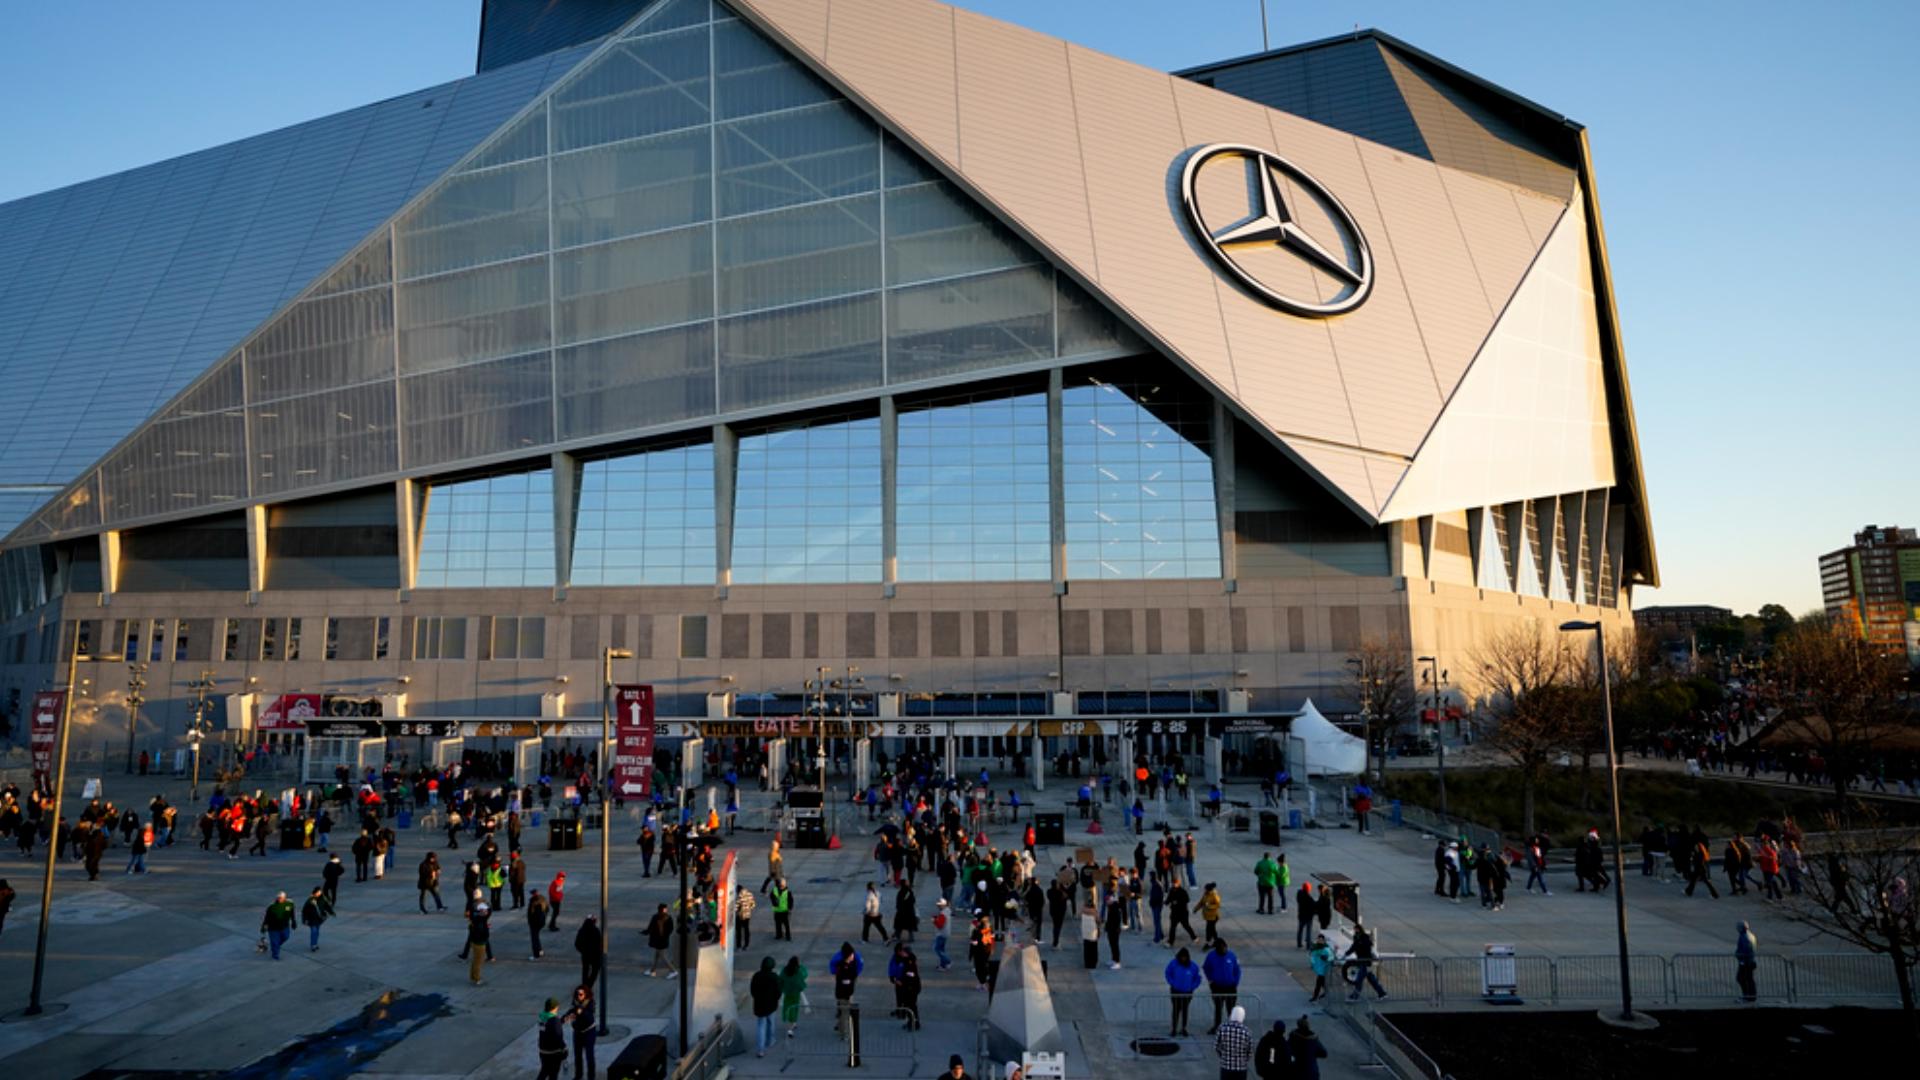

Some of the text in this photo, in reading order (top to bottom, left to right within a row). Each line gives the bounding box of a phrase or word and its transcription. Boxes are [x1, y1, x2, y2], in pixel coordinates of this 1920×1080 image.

[491, 722, 513, 735] CFP
[754, 716, 801, 733] GATE
[1061, 721, 1086, 735] CFP
